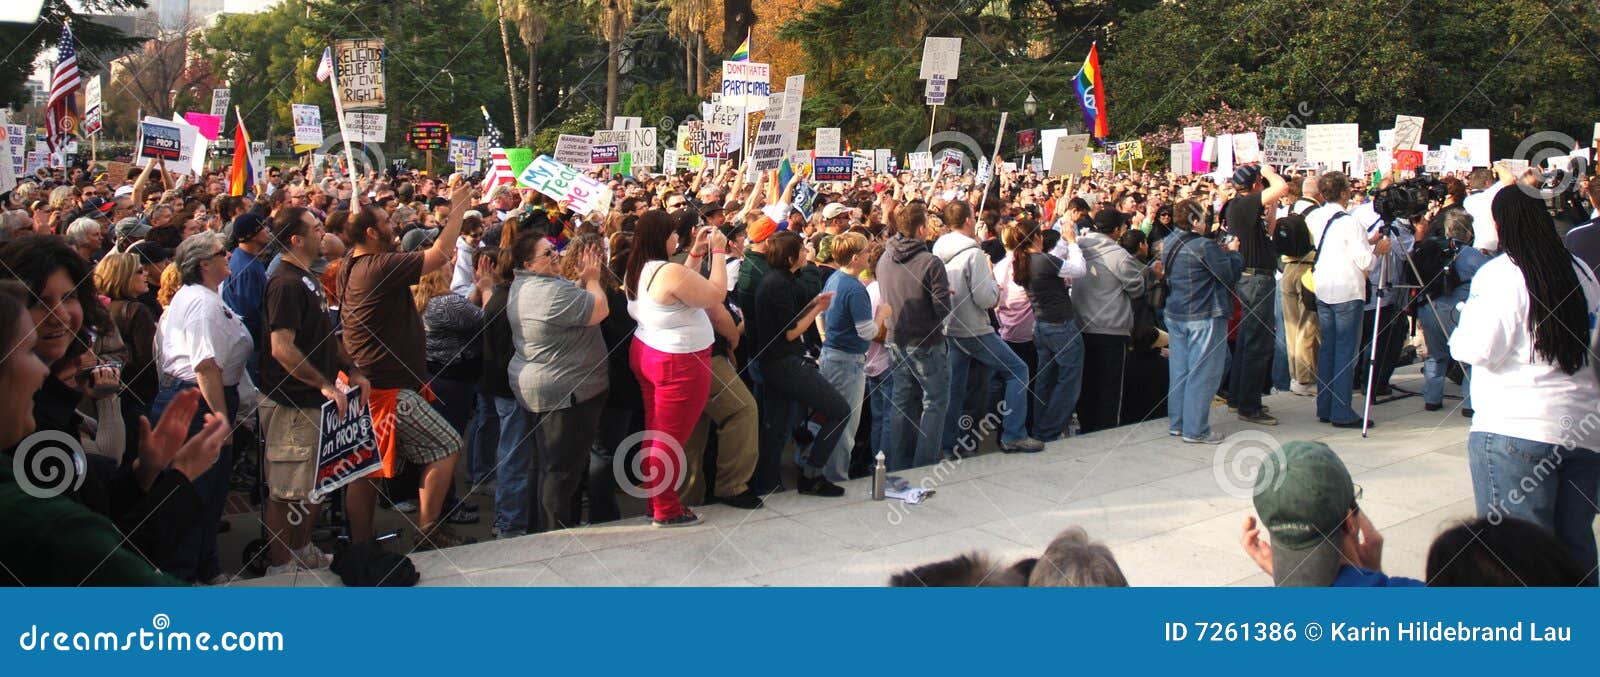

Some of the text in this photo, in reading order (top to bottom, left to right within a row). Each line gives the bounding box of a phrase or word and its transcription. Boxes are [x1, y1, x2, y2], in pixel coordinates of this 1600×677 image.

[337, 62, 367, 77] BELIEF
[344, 88, 379, 103] RIGHT
[156, 138, 174, 148] PROP
[634, 128, 653, 147] NO
[689, 130, 707, 141] SEEN
[710, 132, 723, 140] MY
[567, 186, 590, 210] Me
[322, 442, 334, 457] on
[336, 425, 358, 450] PROP
